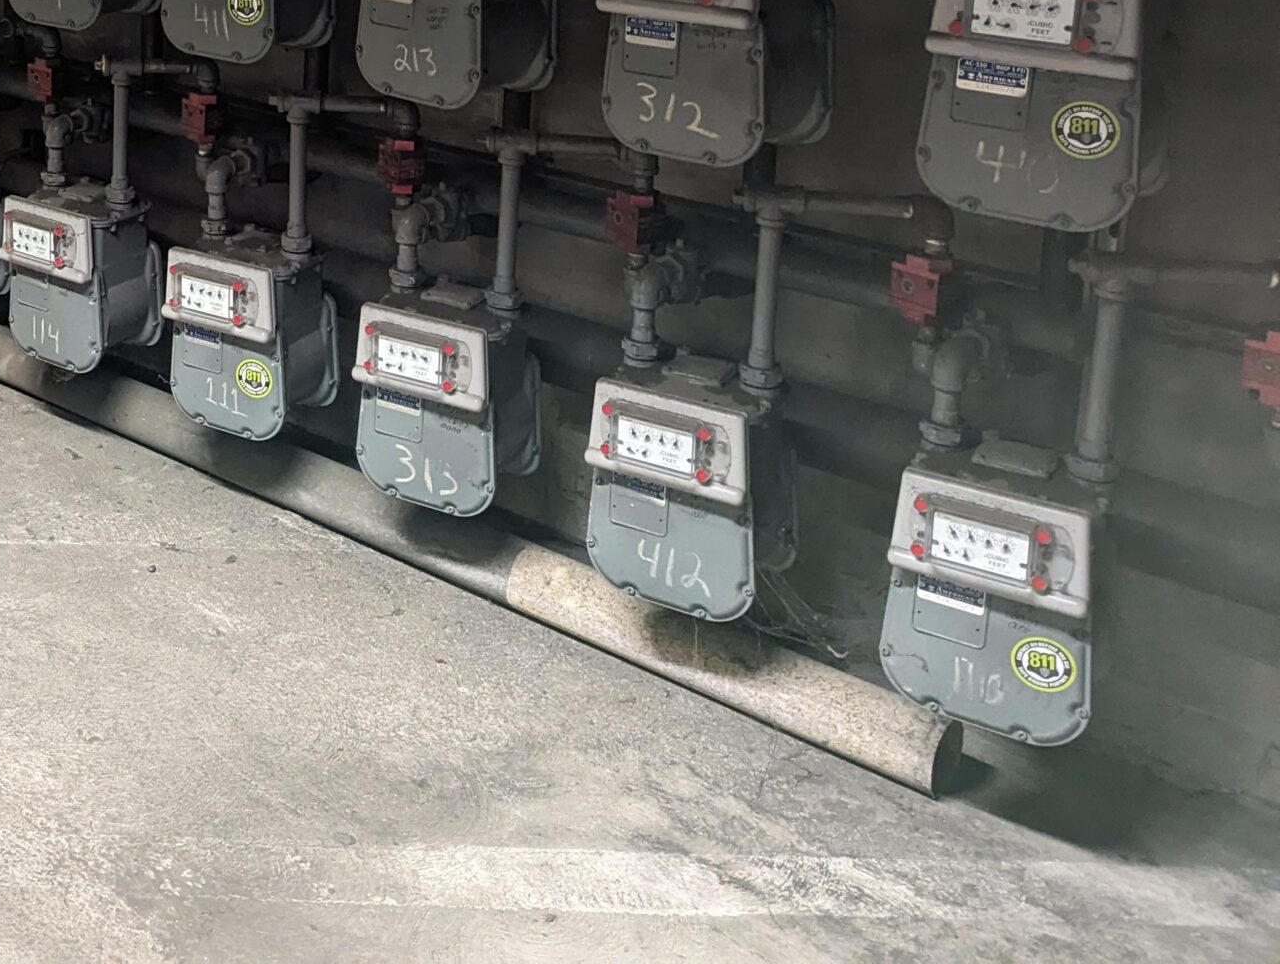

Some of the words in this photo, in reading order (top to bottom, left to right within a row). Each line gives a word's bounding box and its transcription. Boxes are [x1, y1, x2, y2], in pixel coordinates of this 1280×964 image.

[194, 2, 229, 43] 411
[1029, 20, 1054, 29] CUBIC
[1031, 28, 1050, 36] FEET
[393, 43, 438, 76] 213
[976, 72, 1017, 84] AMERICAN
[636, 82, 720, 140] 312
[1071, 117, 1099, 136] 811
[31, 315, 60, 356] 114
[246, 369, 261, 383] 811
[204, 377, 248, 418] 111
[986, 553, 1010, 564] CUBIC
[988, 561, 1006, 569] FEET
[637, 538, 711, 599] 412
[1029, 651, 1056, 671] 811
